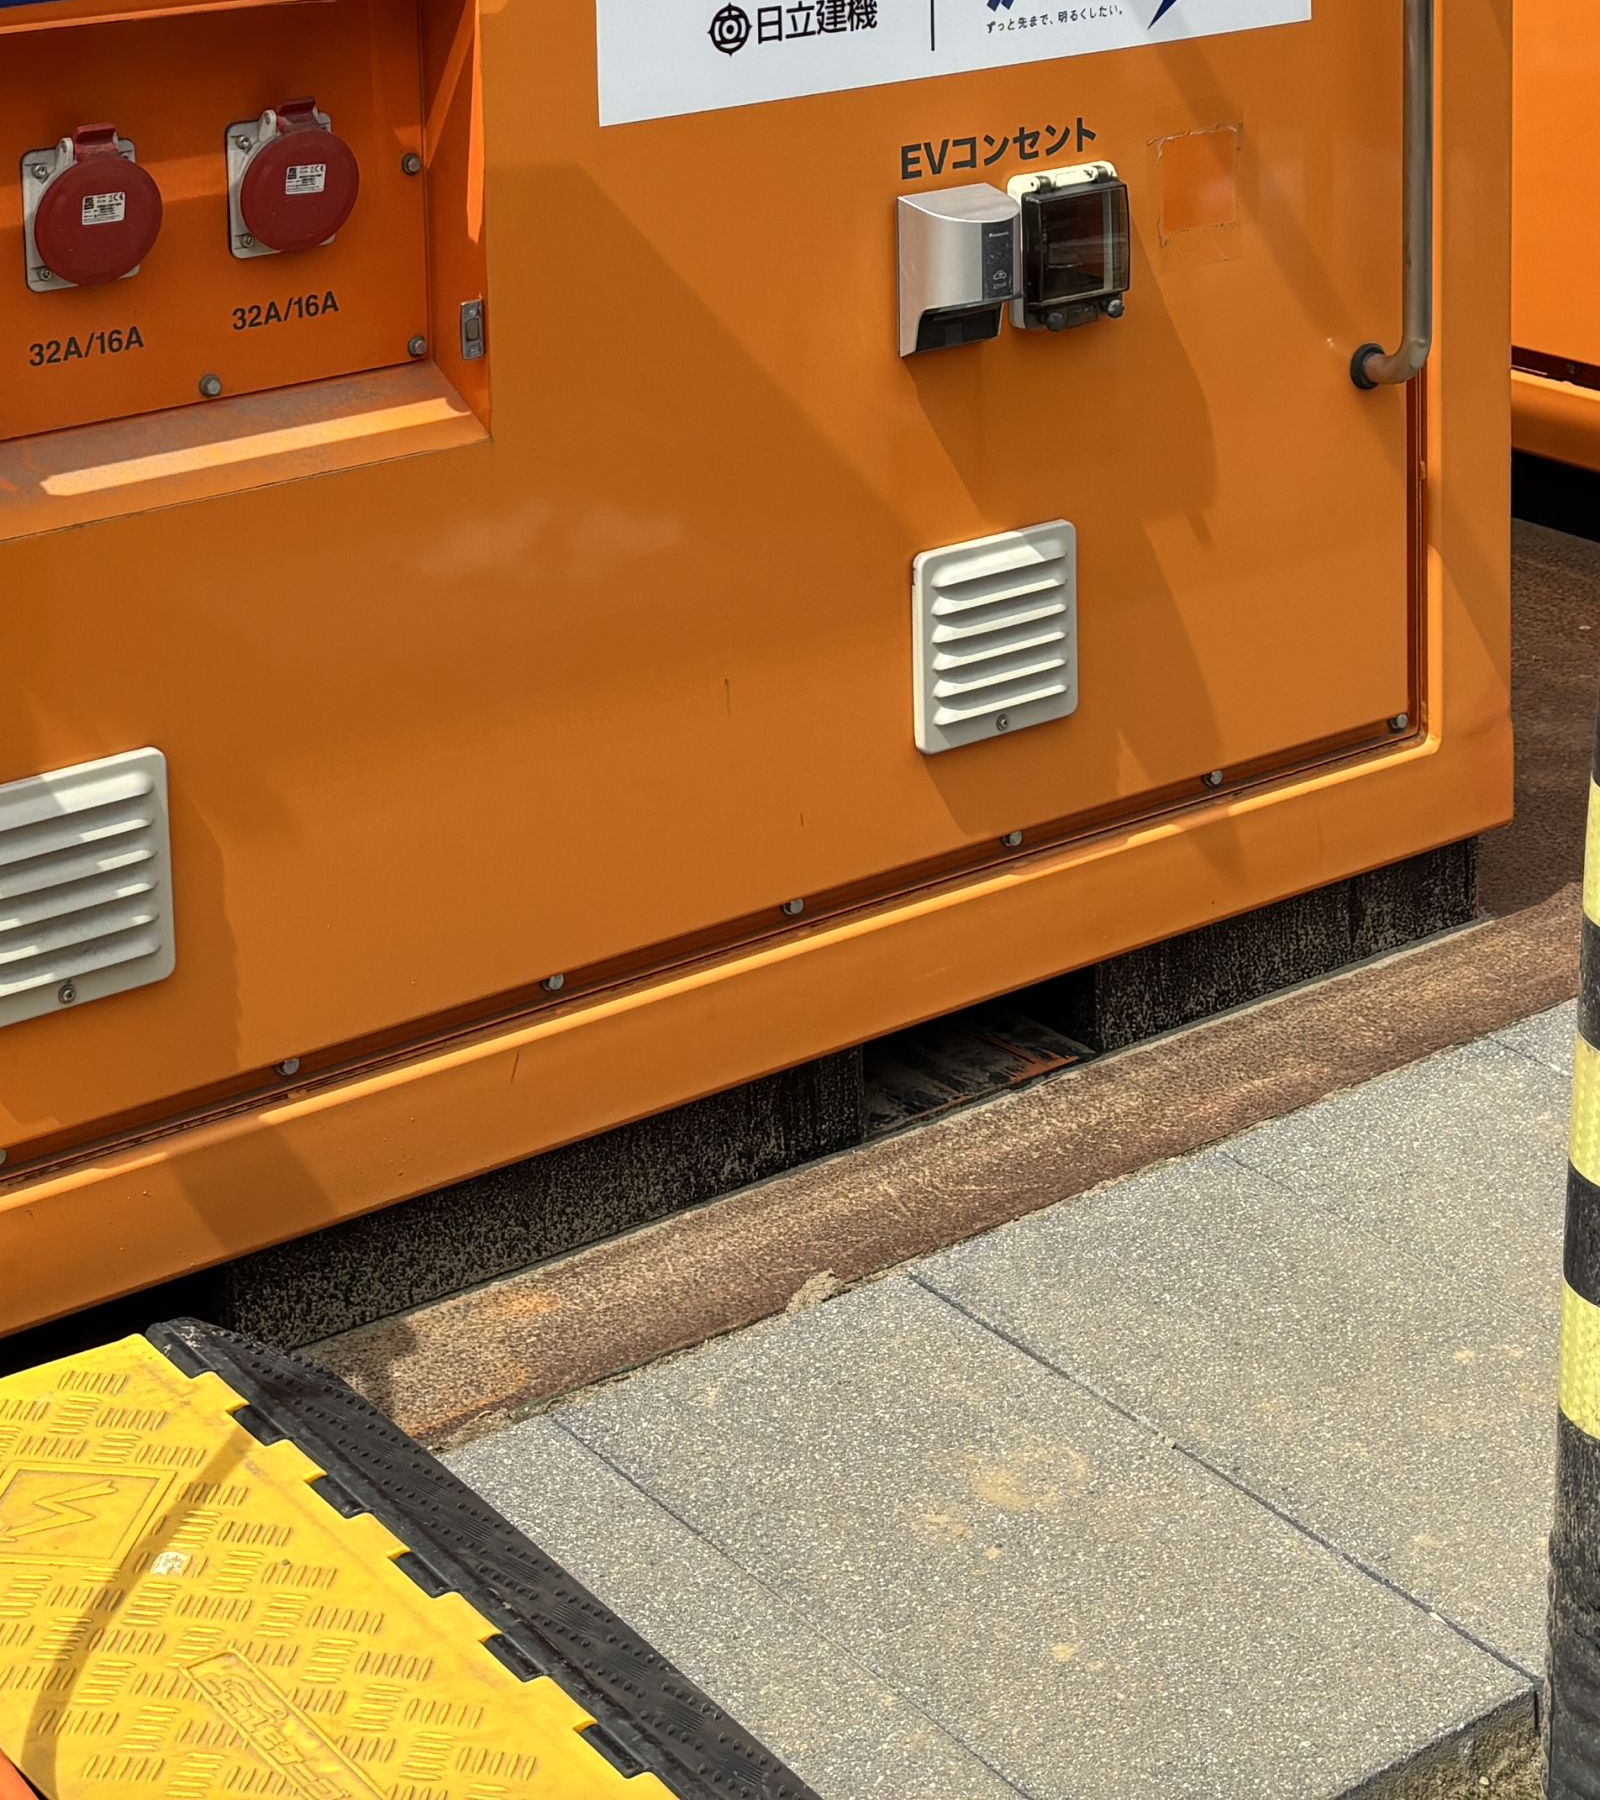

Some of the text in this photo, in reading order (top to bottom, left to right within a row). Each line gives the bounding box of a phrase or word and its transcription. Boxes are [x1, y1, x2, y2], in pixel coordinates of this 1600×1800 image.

[986, 5, 1125, 35] ずっと先まで、明るくしたい。
[901, 117, 1097, 180] EVコンセント
[233, 291, 339, 330] 32A/16A
[29, 327, 144, 367] 32A/16A
